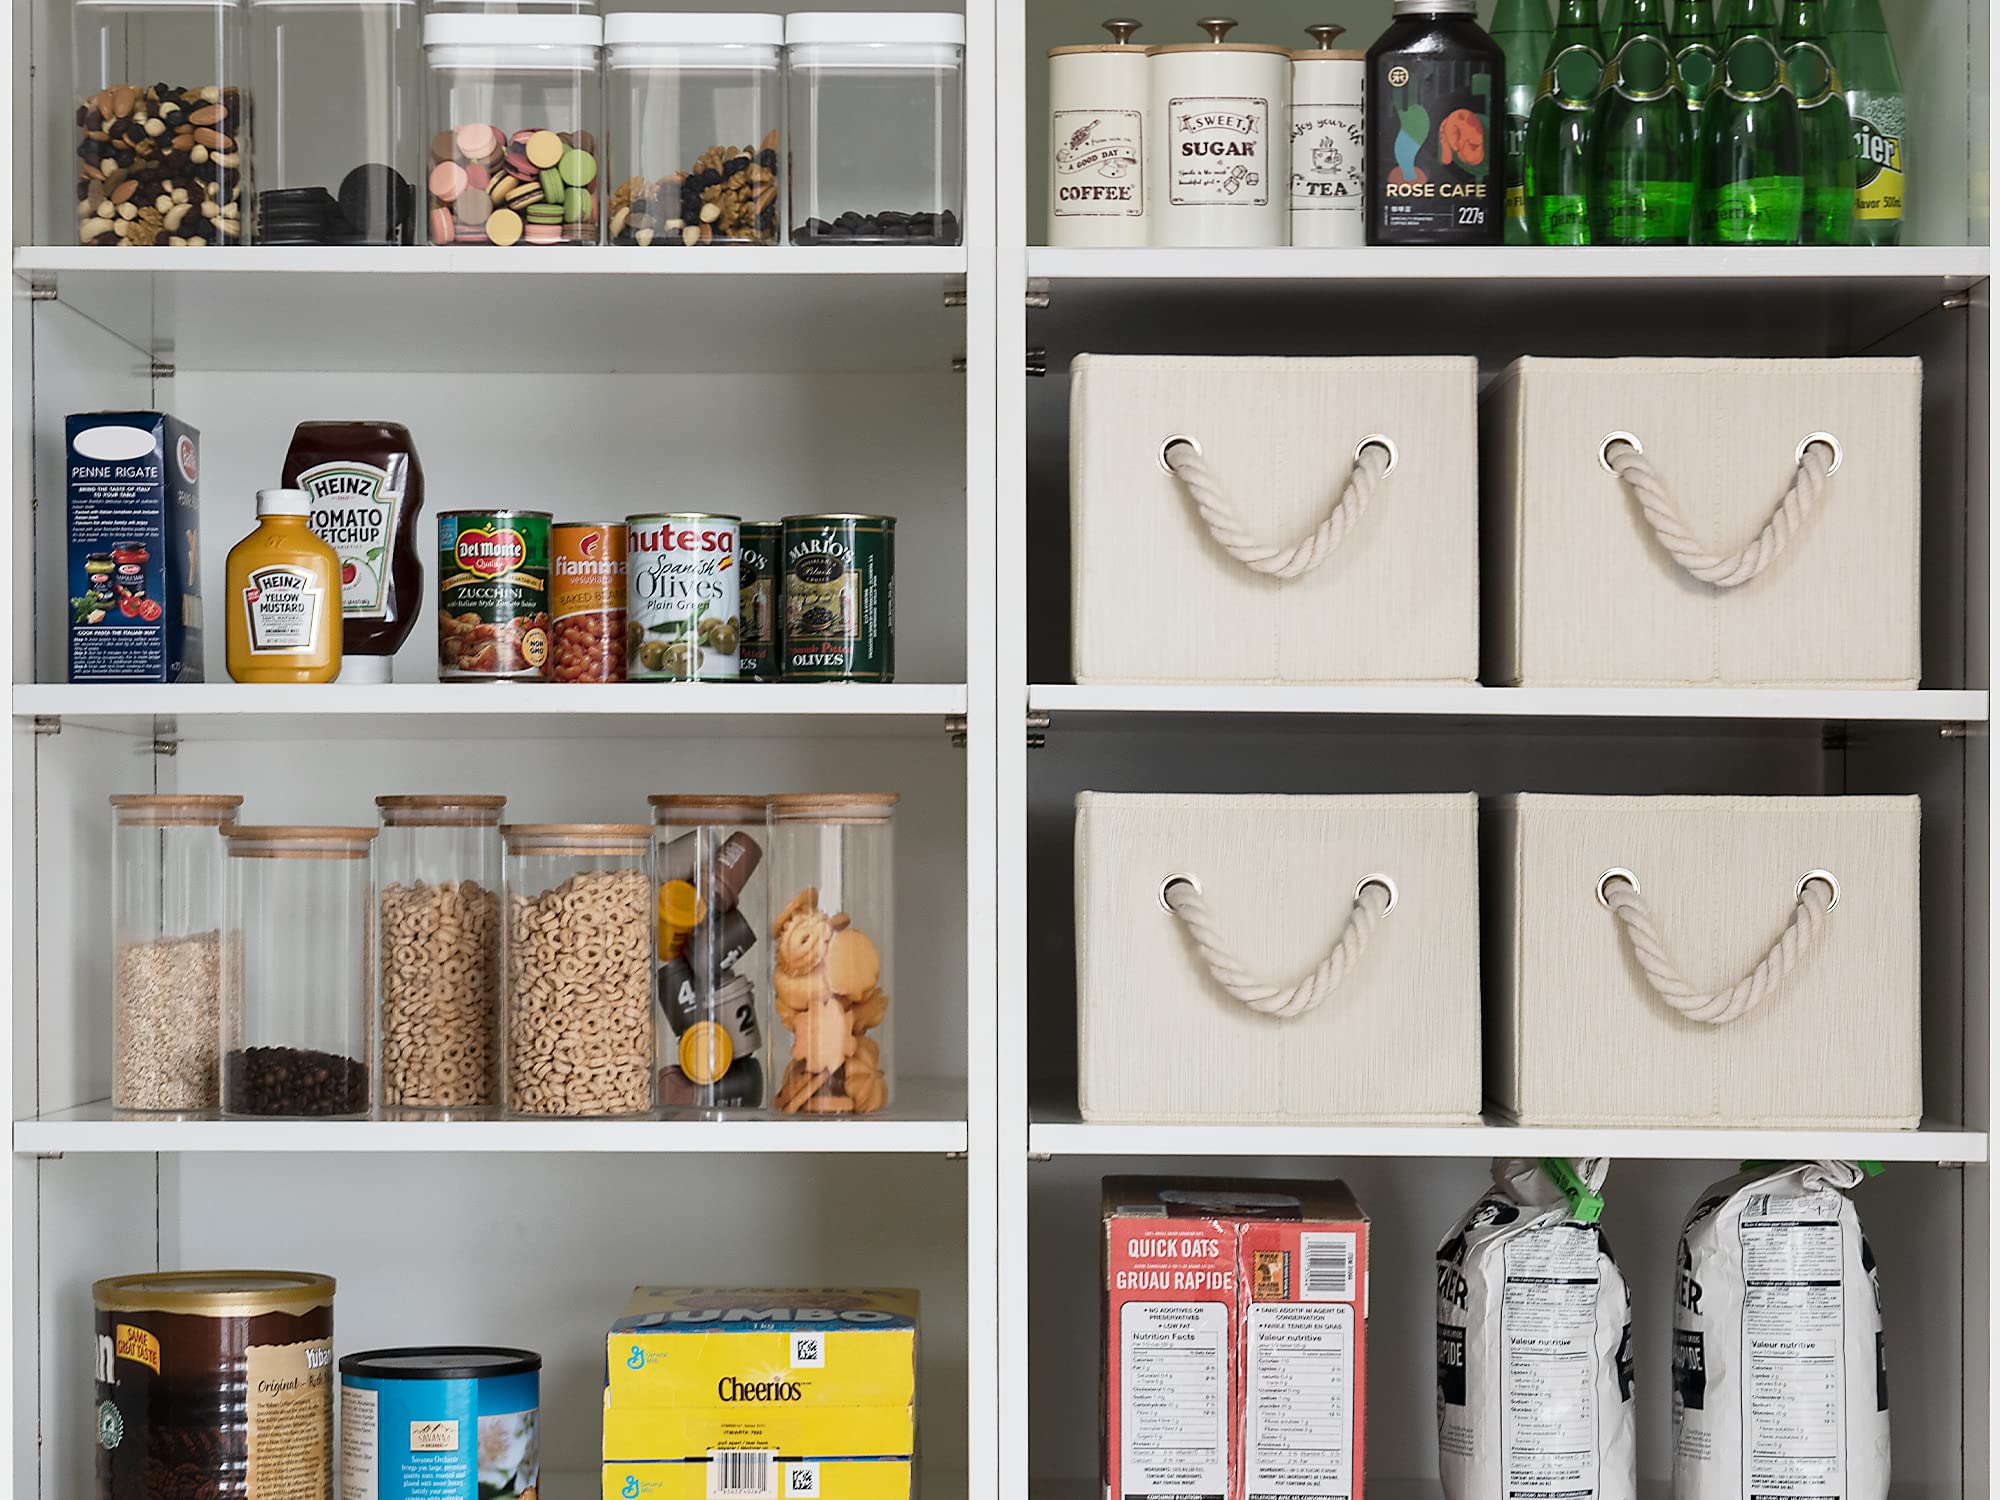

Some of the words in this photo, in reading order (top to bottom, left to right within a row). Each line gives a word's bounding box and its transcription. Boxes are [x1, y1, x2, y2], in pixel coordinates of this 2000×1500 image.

[1196, 115, 1243, 128] SWEET
[1181, 141, 1254, 157] SUGAR
[1853, 125, 1894, 168] rier
[1076, 155, 1098, 168] GOOD
[1101, 149, 1119, 159] DAY
[1059, 186, 1132, 201] COFFEE
[1306, 182, 1349, 196] TEA
[1385, 183, 1436, 198] ROSE
[1439, 183, 1488, 198] CAFE
[1855, 198, 1880, 209] lavor
[71, 466, 111, 478] PENNE
[115, 466, 158, 478] RIGATE
[314, 477, 373, 497] HEINZ
[309, 509, 382, 528] TOMATO
[458, 542, 480, 558] Del
[480, 541, 522, 558] Monte
[789, 536, 855, 564] MARIO'S
[555, 554, 628, 577] fiamma
[647, 553, 715, 581] Spanish
[740, 547, 769, 571] IO'S
[262, 576, 301, 590] HEINZ
[635, 569, 724, 600] Olives
[265, 593, 300, 602] YELLOW
[457, 587, 523, 600] ZUCCHINI
[560, 591, 593, 607] BAKED
[260, 603, 305, 613] MUSTARD
[478, 600, 495, 608] Style
[647, 600, 674, 610] Plain
[678, 599, 711, 610] Green
[792, 653, 845, 667] OLIVES
[677, 980, 697, 1006] 4
[736, 1005, 754, 1033] 2
[1128, 1238, 1179, 1259] QUICK
[1181, 1238, 1220, 1258] OATS
[1116, 1270, 1171, 1291] GRUAU
[1173, 1270, 1234, 1291] RAPIDE
[636, 1307, 895, 1328] JUMBO
[127, 1328, 149, 1346] SAME
[1133, 1333, 1170, 1341] Nutrition
[1172, 1333, 1196, 1341] Facts
[1287, 1334, 1322, 1342] nutritive
[1510, 1337, 1536, 1346] Valeur
[1538, 1338, 1572, 1346] nutritive
[1751, 1340, 1779, 1348] Valeur
[1780, 1341, 1816, 1349] nutritive
[137, 1343, 158, 1365] TASTE
[258, 1376, 299, 1398] Original
[718, 1375, 802, 1402] Cheerios
[411, 1455, 434, 1463] Savanna
